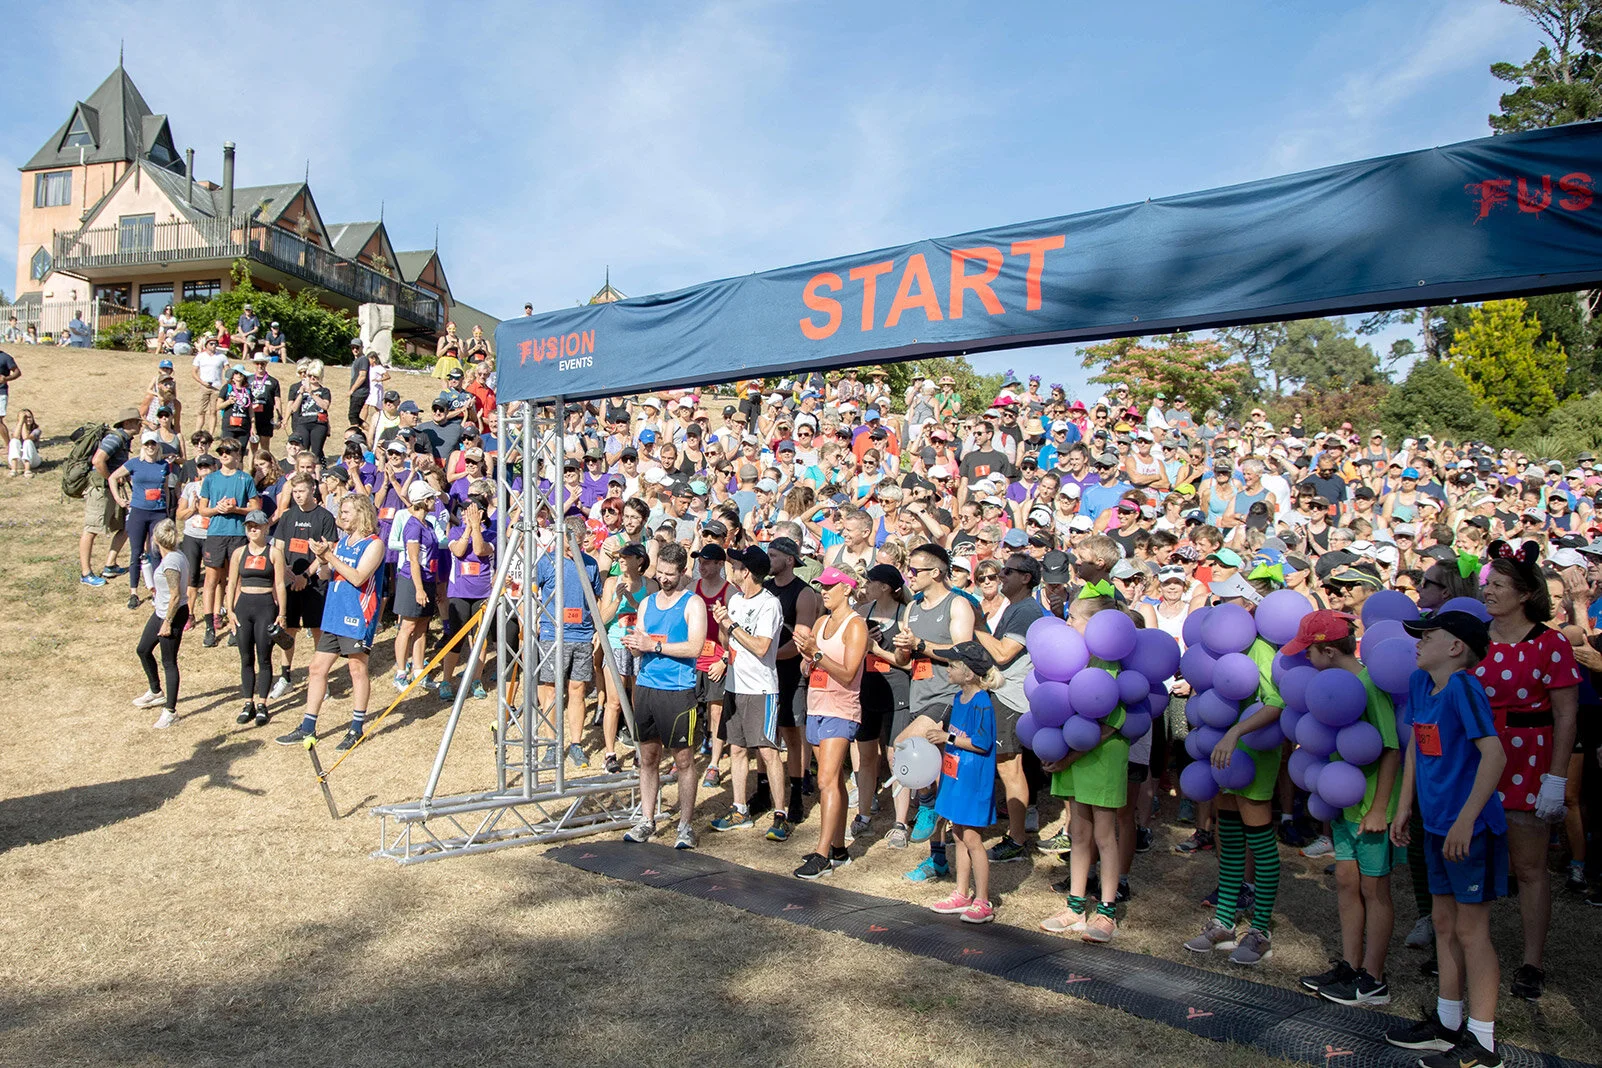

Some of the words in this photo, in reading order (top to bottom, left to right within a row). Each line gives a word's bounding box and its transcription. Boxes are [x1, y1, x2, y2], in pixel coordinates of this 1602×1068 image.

[799, 235, 1066, 341] START
[517, 329, 595, 366] FUSION
[559, 356, 593, 371] EVENTS
